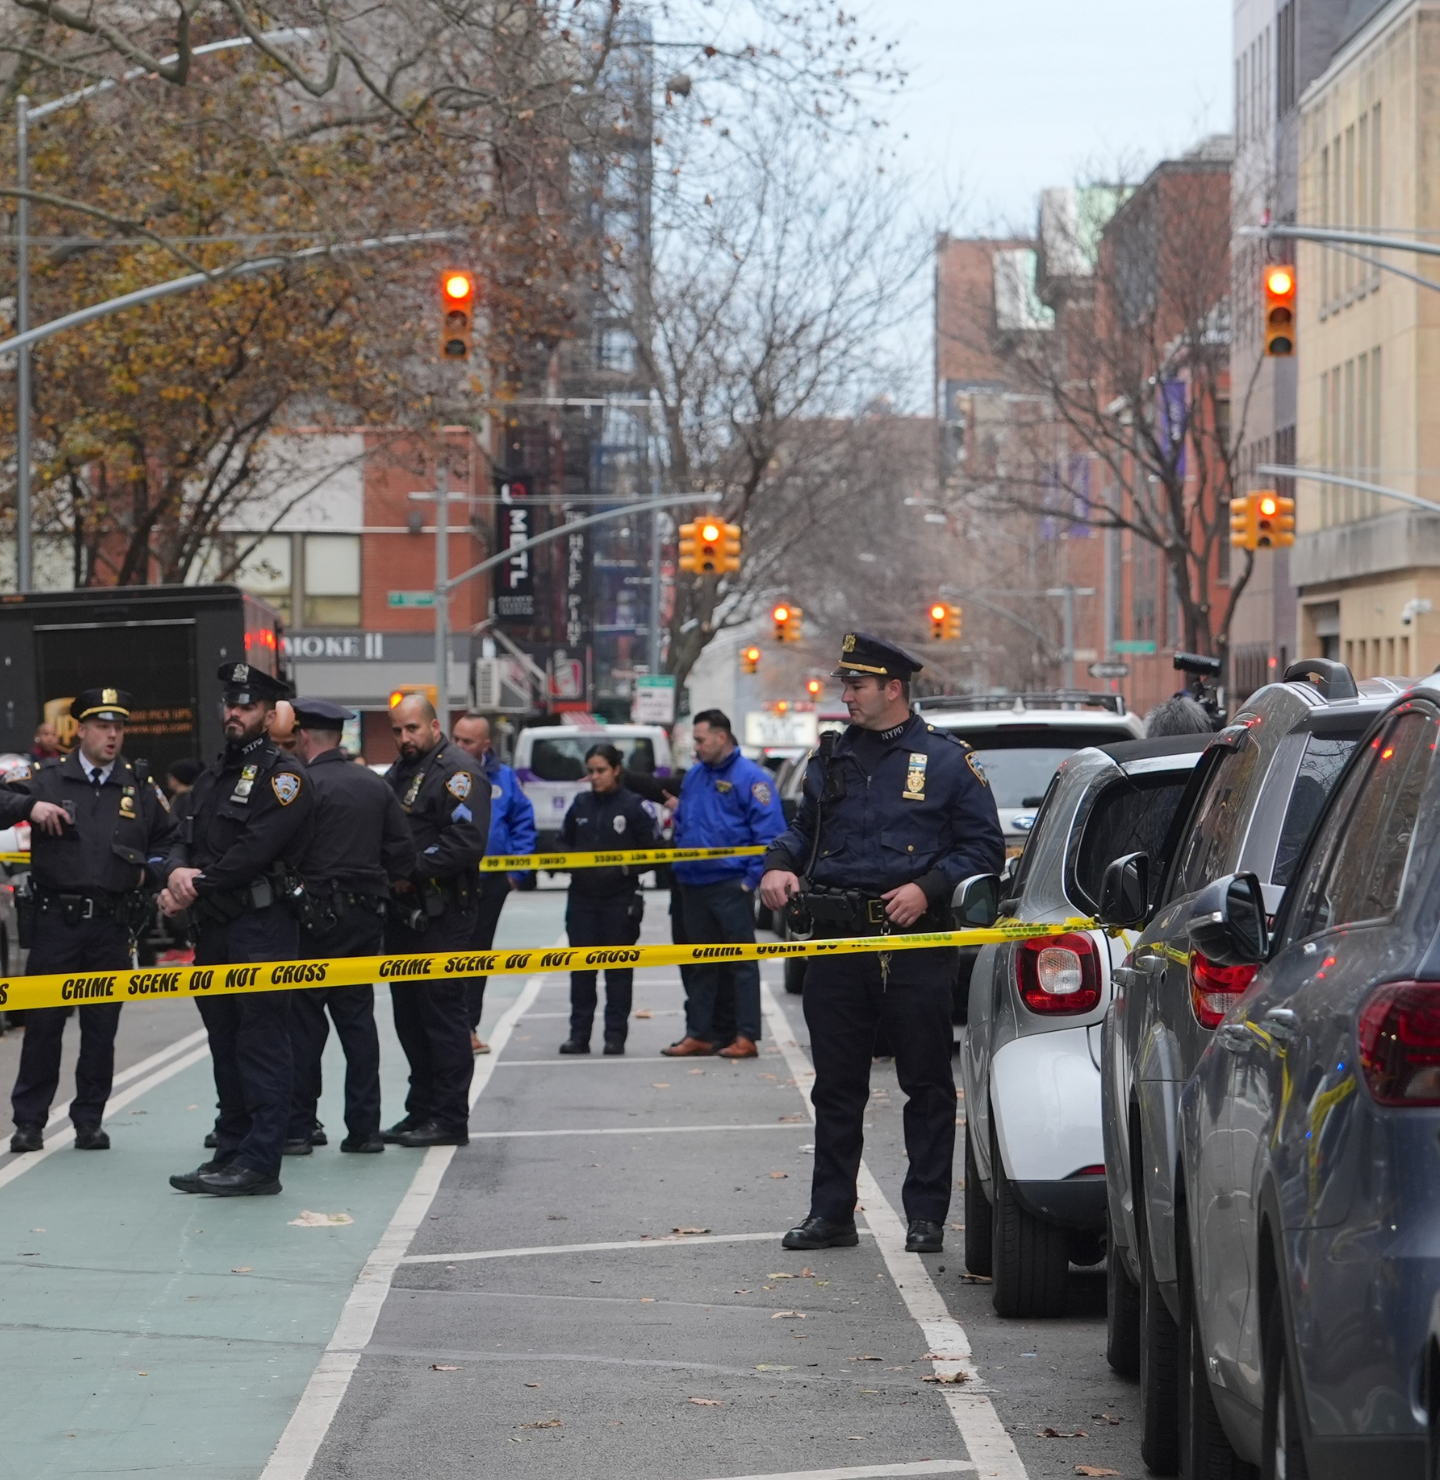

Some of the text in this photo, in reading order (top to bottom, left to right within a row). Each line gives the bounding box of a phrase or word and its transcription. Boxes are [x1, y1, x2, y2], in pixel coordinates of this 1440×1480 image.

[285, 635, 361, 658] MOKE
[881, 725, 904, 741] NYPD
[242, 737, 263, 754] NYPD
[61, 976, 117, 1001] CRIME
[127, 972, 182, 995] SCENE
[189, 970, 215, 991] DO
[225, 967, 262, 988] NOT
[271, 962, 330, 986] CROSS
[379, 958, 437, 977] CRIME
[444, 954, 500, 973] SCENE
[505, 953, 533, 970] DO
[540, 951, 579, 967] NOT
